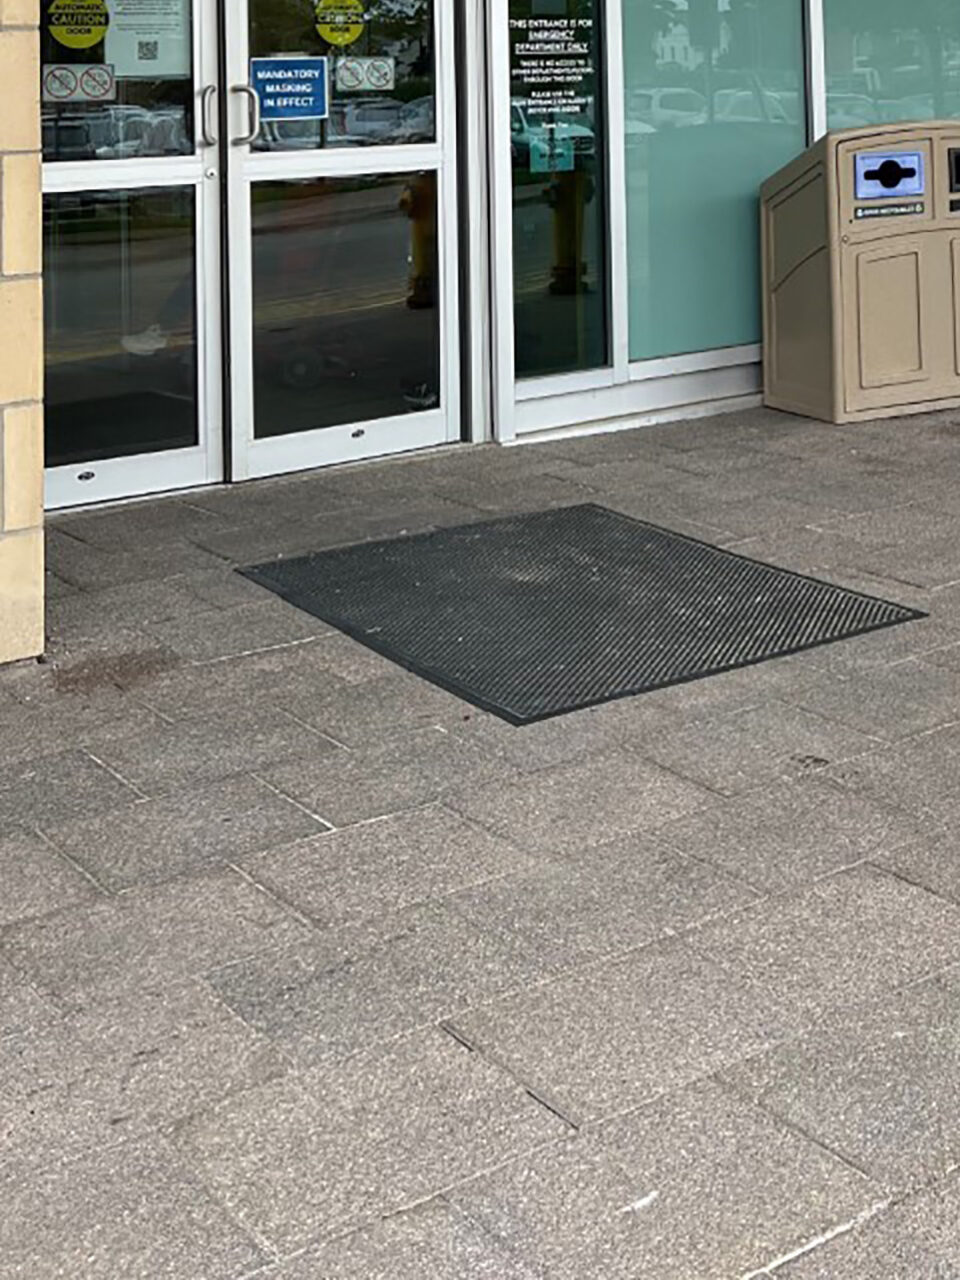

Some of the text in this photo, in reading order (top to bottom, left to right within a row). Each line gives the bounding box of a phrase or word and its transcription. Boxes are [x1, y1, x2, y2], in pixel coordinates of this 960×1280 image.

[54, 3, 105, 11] AUTOMATIC
[51, 14, 106, 25] CAUTION
[509, 19, 527, 29] THIS
[528, 19, 568, 29] ENTRANCE
[578, 19, 593, 28] FOR
[66, 27, 92, 35] DOOR
[528, 30, 575, 40] EMERGENCY
[515, 42, 588, 52] DEPARTMENT ONLY
[257, 69, 320, 79] MANDATORY
[265, 83, 313, 93] MASKING
[263, 97, 315, 108] IN EFFECT
